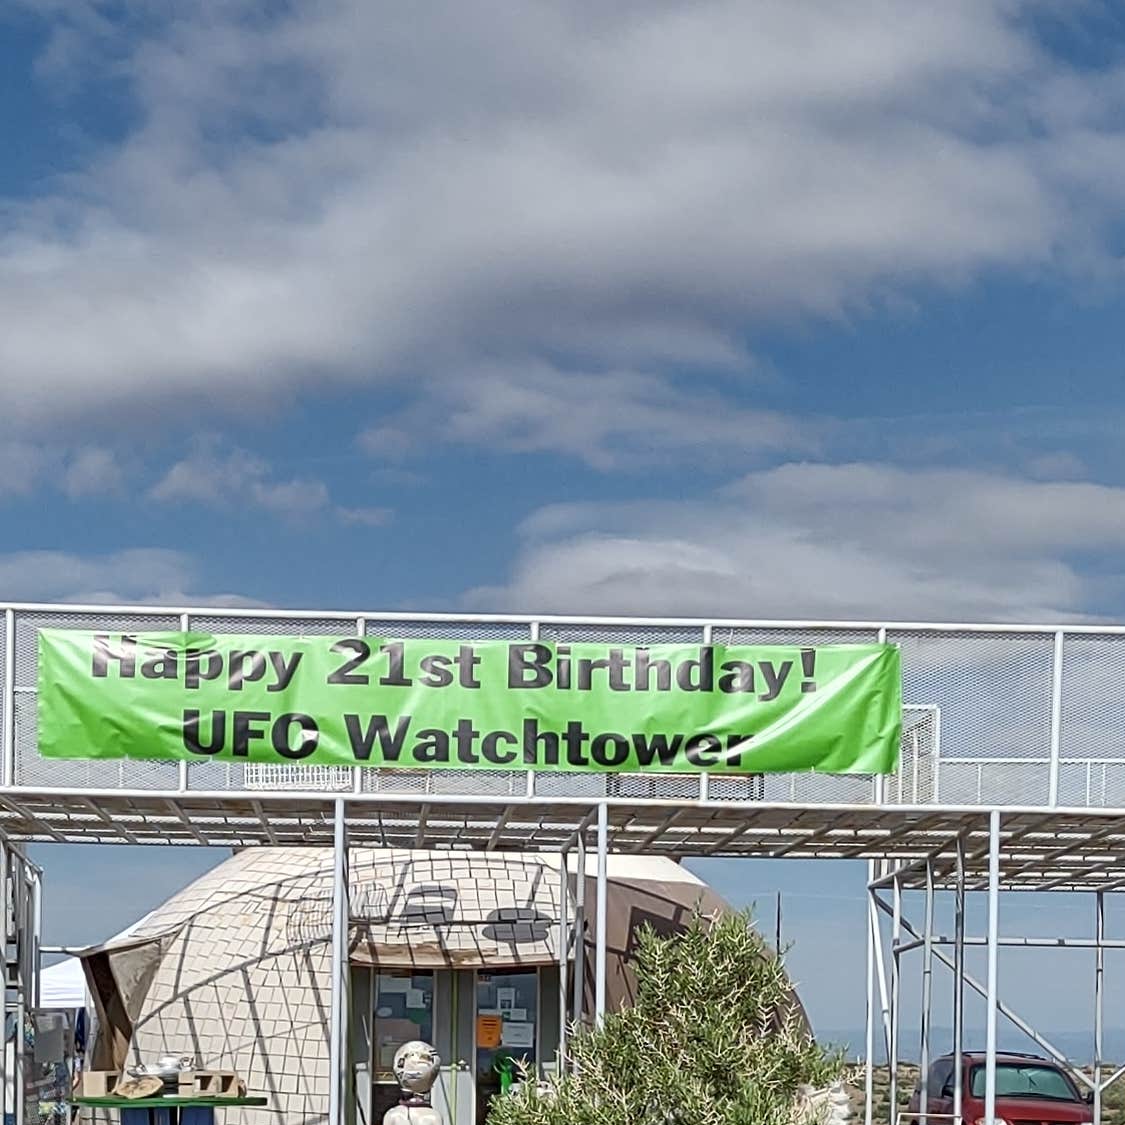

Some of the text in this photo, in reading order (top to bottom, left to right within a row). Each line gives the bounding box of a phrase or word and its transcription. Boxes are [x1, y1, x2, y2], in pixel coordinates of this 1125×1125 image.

[92, 635, 817, 702] Happy 21st Birthday!
[343, 713, 757, 767] Watchtower
